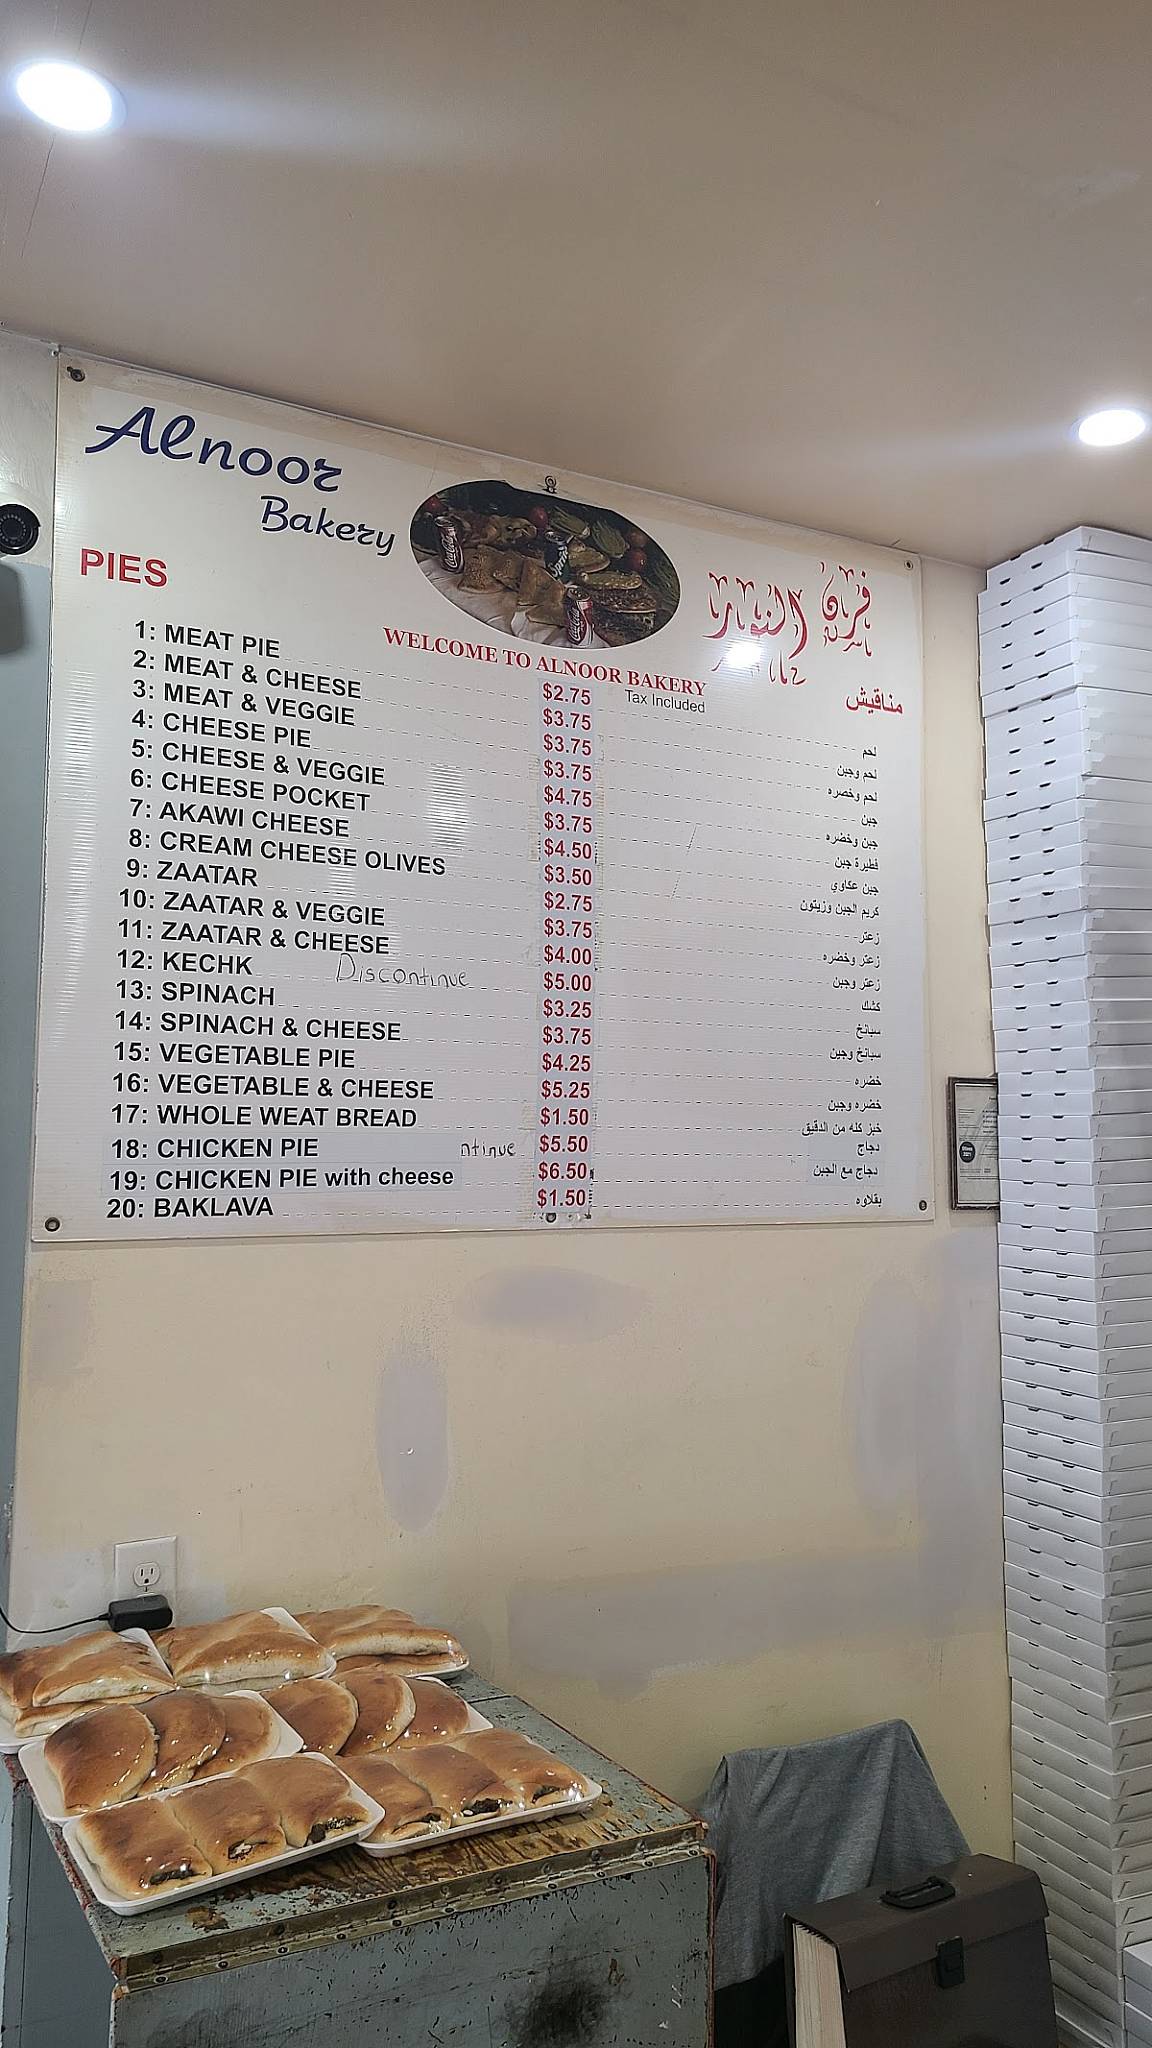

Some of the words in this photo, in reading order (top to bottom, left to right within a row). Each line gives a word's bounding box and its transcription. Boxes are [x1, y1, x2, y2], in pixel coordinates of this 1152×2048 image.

[85, 406, 342, 492] Alnoor
[261, 495, 395, 556] Bakery
[80, 547, 168, 588] PIES
[135, 620, 155, 641] 1:
[165, 623, 235, 651] MEAT
[242, 635, 280, 659] PIE
[133, 649, 155, 670] 2:
[164, 653, 234, 680] MEAT
[241, 664, 258, 685] &
[266, 668, 362, 700] CHEESE
[382, 626, 498, 664] WELCOME
[502, 649, 531, 669] TO
[535, 656, 623, 684] ALNOOR
[627, 670, 706, 698] BAKERY
[132, 679, 154, 700] 3:
[164, 682, 234, 709] MEAT
[240, 693, 258, 713] &
[264, 695, 357, 727] VEGGIE
[542, 681, 591, 706] $2.75
[624, 688, 648, 705] Tax
[652, 692, 706, 714] Included
[845, 686, 904, 715] مناقيش
[131, 708, 153, 729] 4:
[163, 712, 266, 743] CHEESE
[274, 725, 311, 749] PIE
[542, 707, 592, 731] $3.75
[543, 733, 592, 756] $3.75
[131, 738, 153, 759] 5:
[162, 742, 265, 772] CHEESE
[273, 754, 290, 775] &
[296, 757, 385, 786] VEGGIE
[543, 758, 592, 782] $3.75
[130, 768, 152, 789] 6:
[161, 771, 265, 801] CHEESE
[274, 784, 370, 811] POCKET
[543, 784, 592, 808] $4.75
[129, 798, 151, 819] 7:
[158, 801, 244, 828] AKAWI
[251, 810, 350, 838] CHEESE
[543, 810, 593, 834] $3.75
[128, 828, 150, 849] 8:
[160, 830, 252, 858] CREAM
[260, 840, 357, 868] CHEESE
[364, 850, 446, 876] OLIVES
[543, 837, 593, 860] $4.50
[126, 858, 148, 879] 9:
[156, 860, 258, 888] ZAATAR
[543, 863, 592, 886] $3.50
[119, 888, 155, 910] 10:
[163, 891, 265, 918] ZAATAR
[271, 899, 289, 919] &
[295, 901, 385, 927] VEGGIE
[543, 890, 593, 913] $2.75
[118, 918, 152, 940] 11:
[160, 921, 262, 947] ZAATAR
[269, 928, 287, 948] &
[294, 930, 390, 955] CHEESE
[543, 917, 593, 939] $3.75
[117, 948, 153, 970] 12:
[163, 951, 253, 976] KECHK
[543, 943, 592, 966] $4.00
[336, 952, 469, 988] Discontinue
[543, 970, 592, 992] $5.00
[116, 979, 152, 1000] 13:
[161, 981, 275, 1006] SPINACH
[542, 998, 592, 1019] $3.25
[115, 1010, 151, 1031] 14:
[160, 1012, 274, 1036] SPINACH
[281, 1017, 299, 1037] &
[306, 1018, 401, 1041] CHEESE
[542, 1024, 592, 1046] $3.75
[114, 1041, 150, 1062] 15:
[158, 1042, 311, 1067] VEGETABLE
[318, 1048, 355, 1069] PIE
[541, 1052, 591, 1073] $4.25
[112, 1072, 149, 1093] 16:
[157, 1073, 310, 1097] VEGETABLE
[317, 1077, 334, 1098] &
[341, 1078, 434, 1100] CHEESE
[540, 1079, 591, 1101] $5.25
[111, 1103, 148, 1124] 17:
[156, 1104, 252, 1126] WHOLE
[259, 1106, 330, 1126] WEAT
[336, 1107, 417, 1128] BREAD
[539, 1106, 589, 1128] $1.50
[111, 1138, 148, 1159] 18:
[157, 1138, 272, 1159] CHICKEN
[280, 1138, 319, 1157] PIE
[538, 1133, 589, 1155] $5.50
[110, 1170, 146, 1191] 19:
[155, 1169, 271, 1191] CHICKEN
[279, 1168, 317, 1188] PIE
[324, 1167, 371, 1187] with
[378, 1166, 454, 1186] cheese
[537, 1160, 588, 1182] $6.50
[106, 1198, 144, 1219] 20:
[153, 1196, 274, 1218] BAKLAVA
[536, 1188, 586, 1209] $1.50
